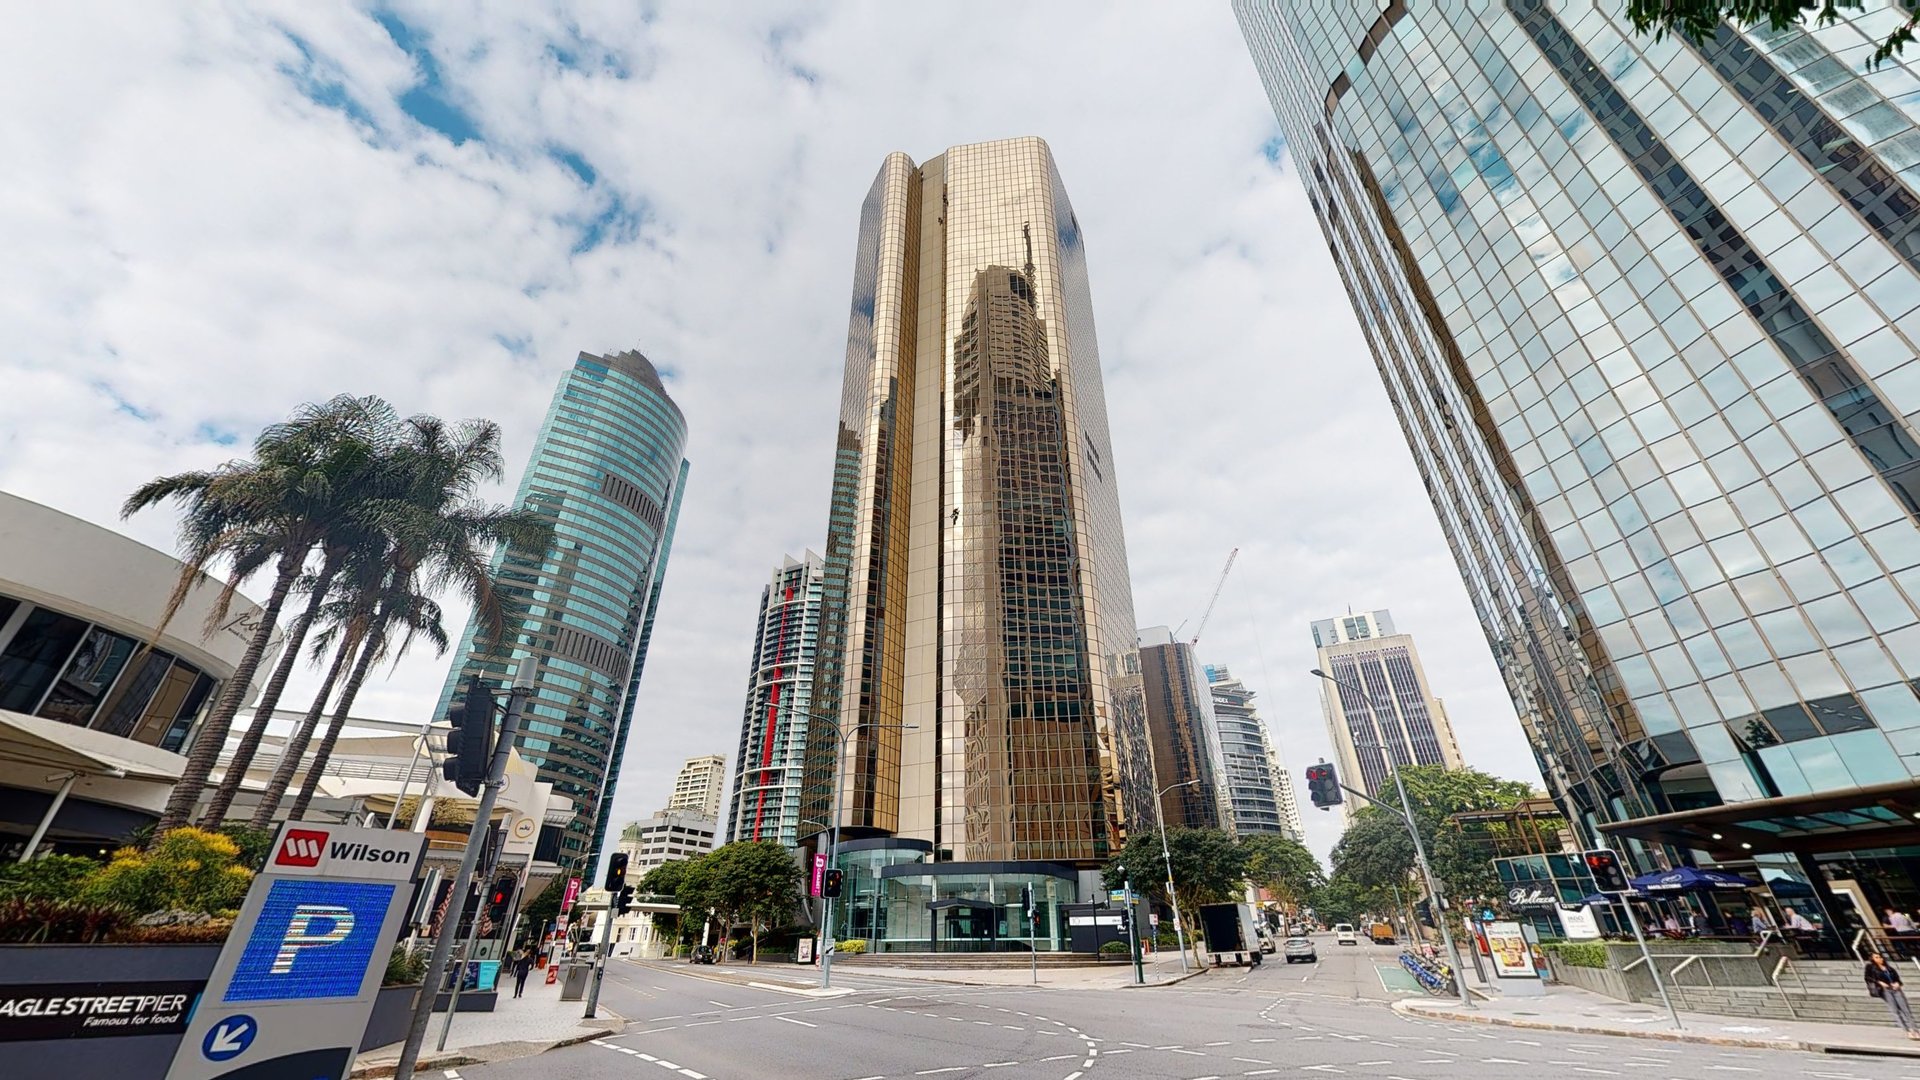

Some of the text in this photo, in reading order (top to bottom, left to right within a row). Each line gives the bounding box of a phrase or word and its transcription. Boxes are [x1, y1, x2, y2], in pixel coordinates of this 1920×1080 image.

[330, 841, 410, 864] Wilson
[269, 904, 355, 974] P
[0, 997, 65, 1016] AGLE
[83, 1013, 179, 1027] Famous for food
